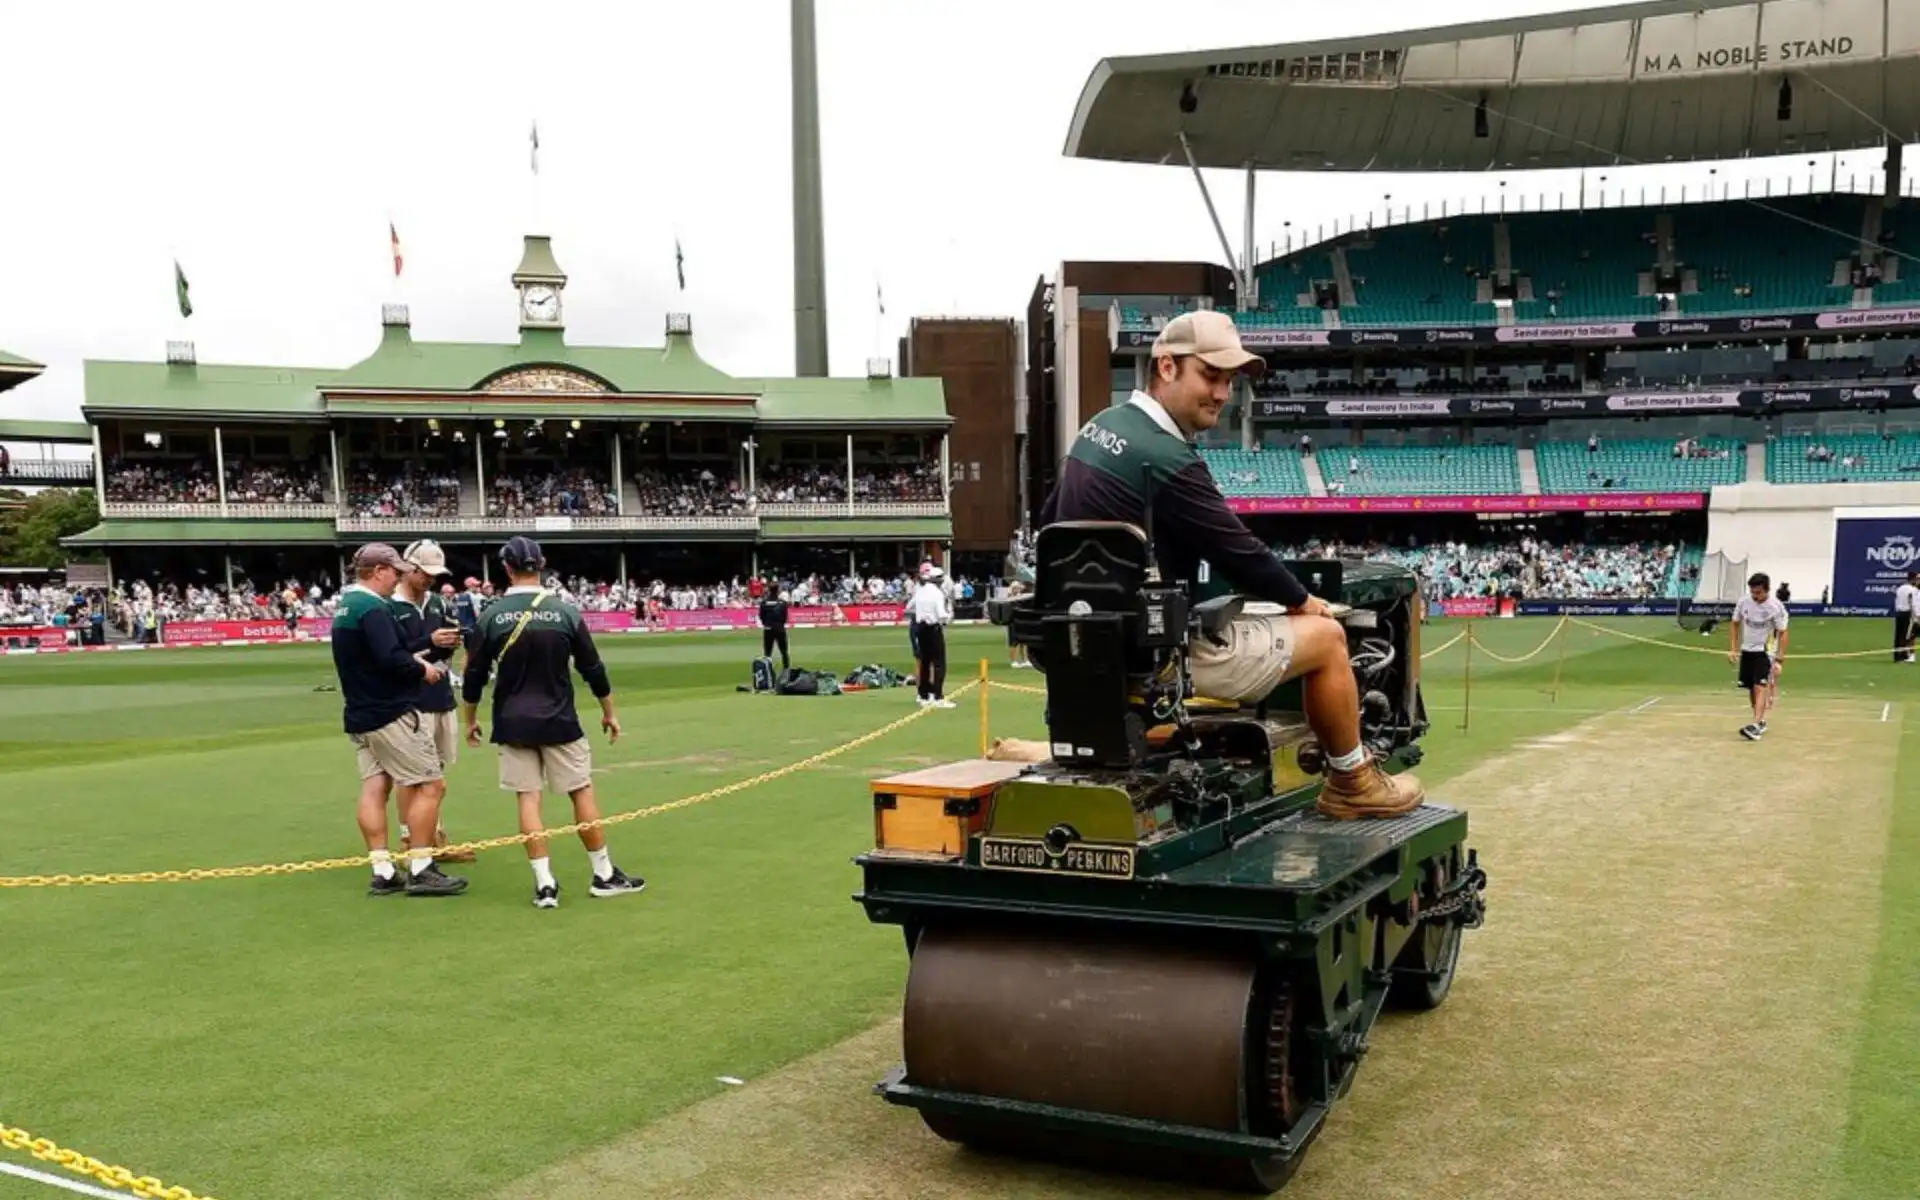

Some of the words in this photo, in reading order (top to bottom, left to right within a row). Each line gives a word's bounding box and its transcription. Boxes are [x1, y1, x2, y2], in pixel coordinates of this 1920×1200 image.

[1644, 54, 1661, 72] M
[1667, 53, 1682, 70] A
[1696, 45, 1768, 67] NOBLE
[1780, 36, 1853, 60] STAND
[1083, 422, 1128, 456] OUNDS
[495, 610, 562, 625] GRONDS
[984, 843, 1046, 866] BARFORD
